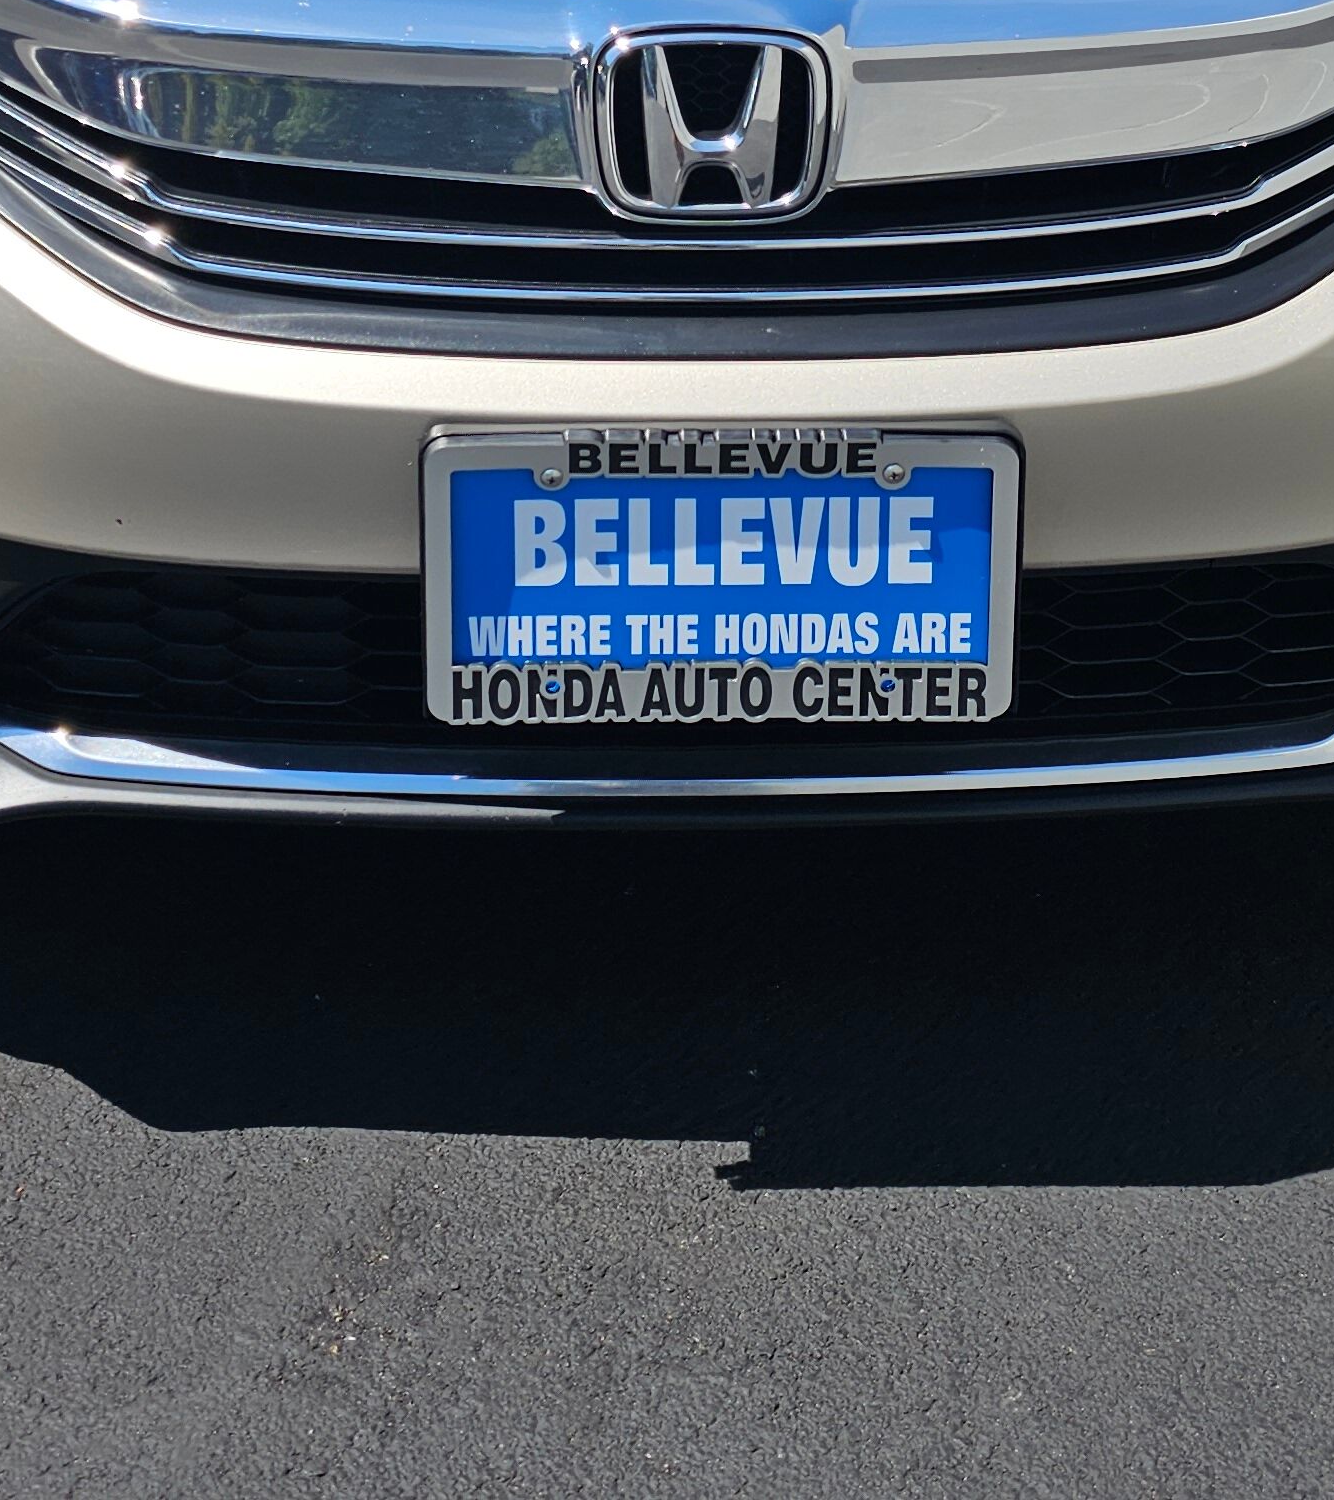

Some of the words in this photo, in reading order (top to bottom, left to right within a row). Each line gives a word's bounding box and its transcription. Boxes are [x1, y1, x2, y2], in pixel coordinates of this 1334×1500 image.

[569, 442, 878, 476] BELLEVUE
[514, 496, 935, 588] BELLEVUE
[468, 615, 612, 658] WHERE
[626, 614, 699, 656] THE
[714, 613, 879, 656] HONDAS
[892, 612, 972, 654] ARE
[452, 666, 624, 720] HONDA
[640, 665, 772, 719] AUTO
[792, 666, 988, 719] CENTER
